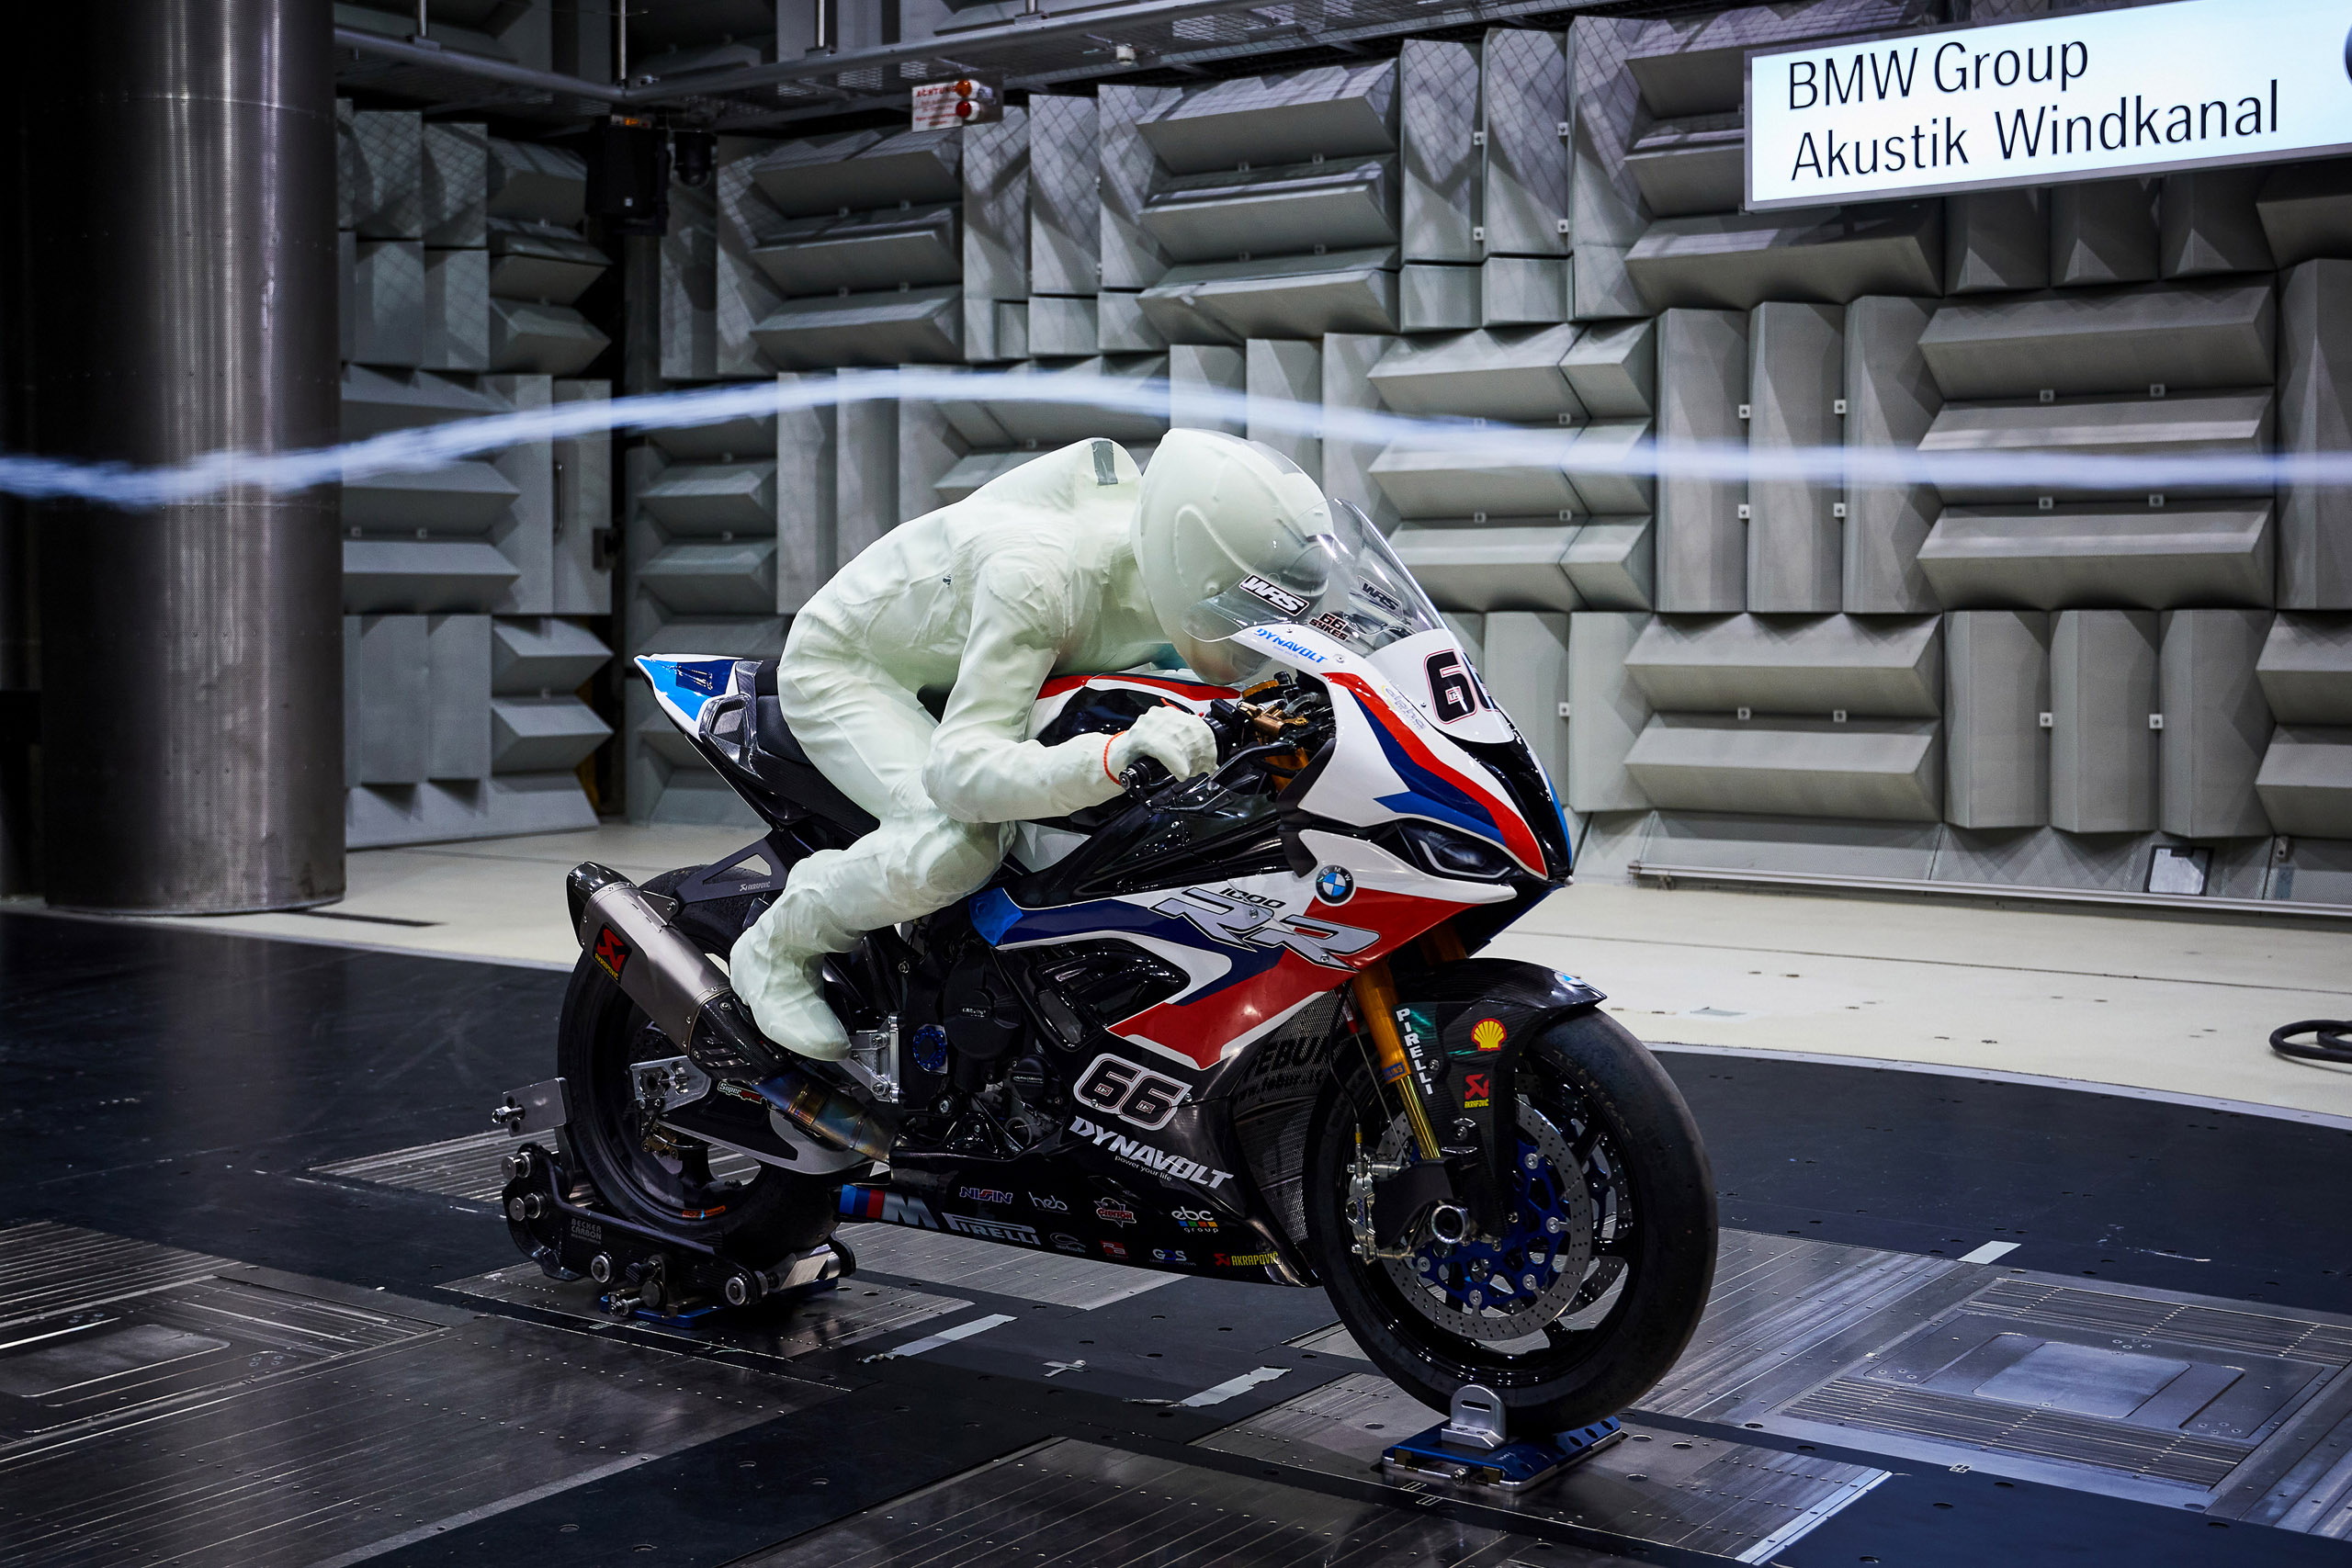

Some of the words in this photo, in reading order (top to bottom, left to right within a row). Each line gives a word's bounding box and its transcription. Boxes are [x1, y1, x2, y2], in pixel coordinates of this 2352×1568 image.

[1789, 47, 1918, 109] BMW
[1933, 39, 2089, 93] Group
[1791, 117, 1969, 182] Akustik
[1996, 79, 2279, 161] Windkanal
[1243, 576, 1306, 611] WRS
[1309, 618, 1349, 640] SYKES
[1319, 614, 1347, 630] 66
[1254, 627, 1329, 663] DYNAVOLT
[1322, 866, 1352, 882] BMW
[1219, 887, 1286, 909] 1000
[1396, 1008, 1434, 1095] PIRELLI
[1076, 1055, 1188, 1129] 66
[1069, 1115, 1234, 1189] DYNAVOLT
[1114, 1155, 1140, 1169] power
[1140, 1162, 1159, 1178] your
[1159, 1171, 1172, 1182] life
[571, 1217, 602, 1234] BECKER
[1170, 1205, 1215, 1221] ebc
[571, 1225, 602, 1241] CARBON
[941, 1212, 1042, 1246] PIRELLI
